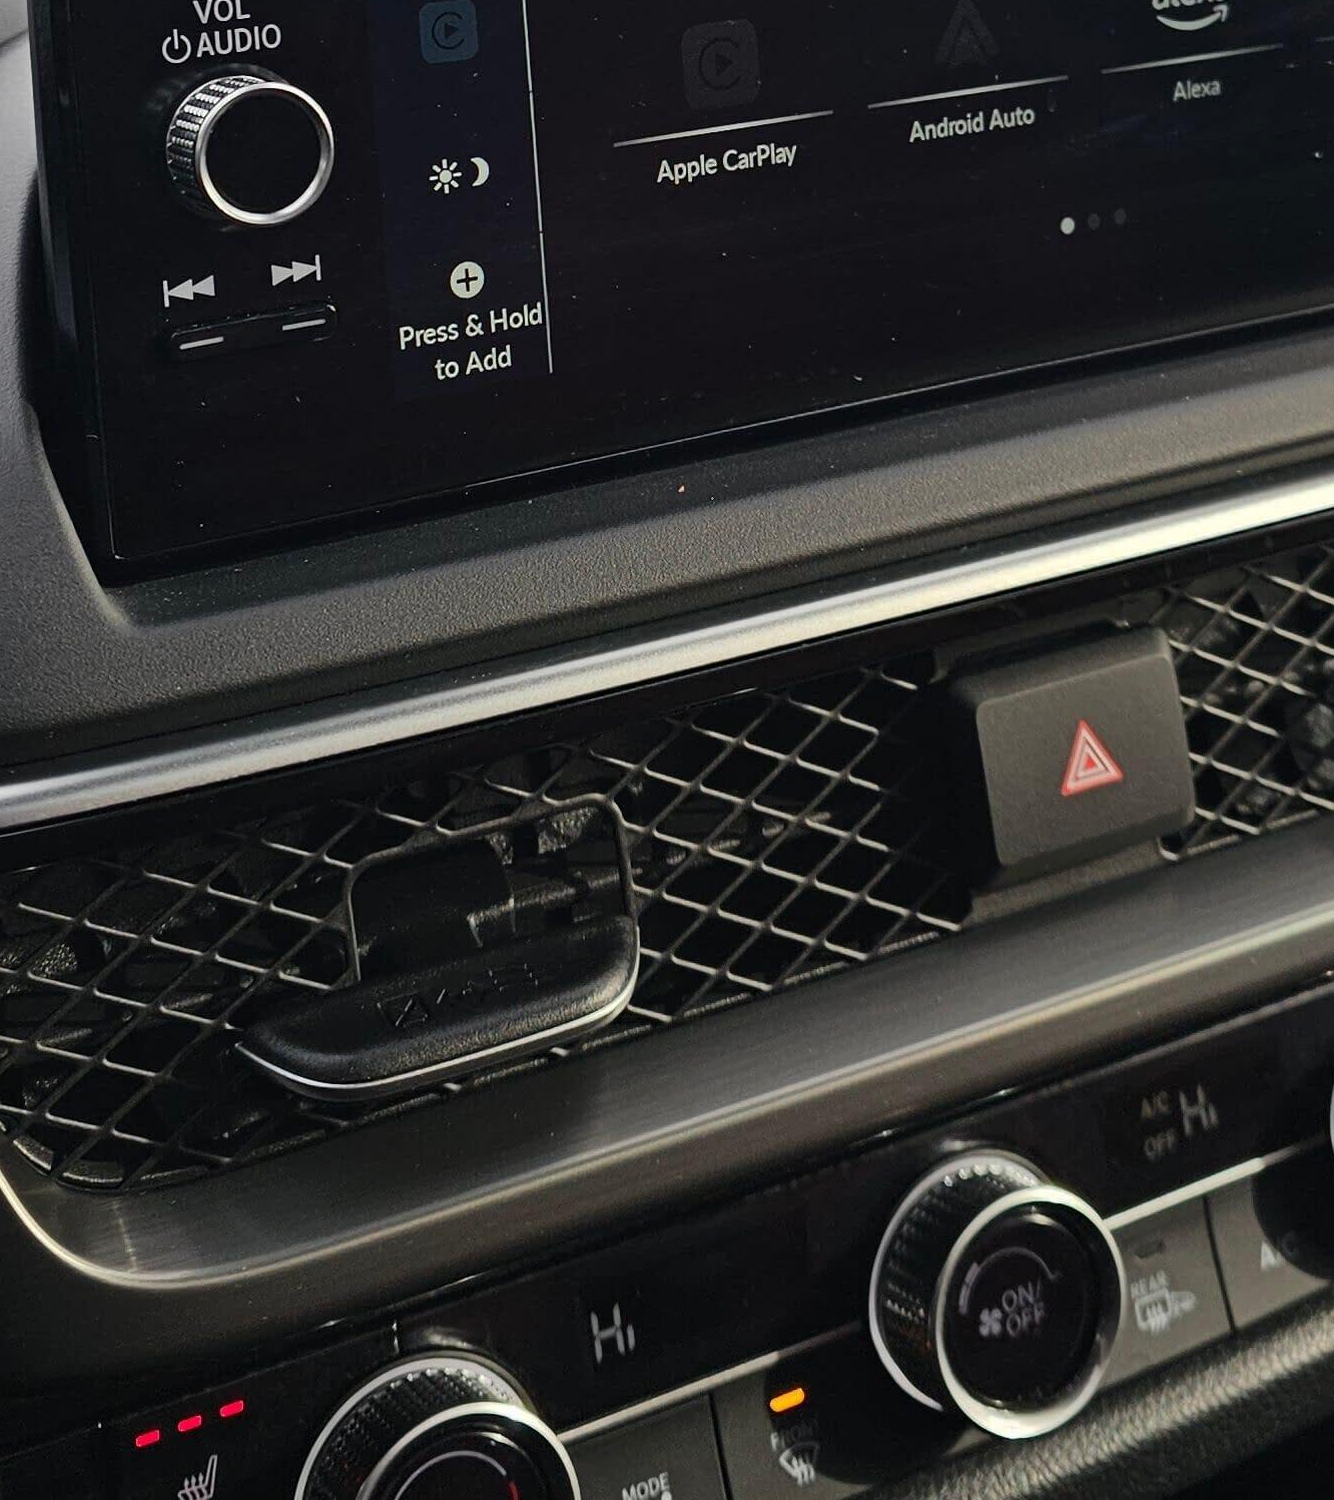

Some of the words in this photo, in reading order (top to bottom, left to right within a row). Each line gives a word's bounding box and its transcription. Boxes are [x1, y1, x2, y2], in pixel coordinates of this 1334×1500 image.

[196, 22, 282, 58] AUDIO
[1172, 79, 1221, 102] Alexa
[909, 110, 985, 143] Android
[988, 106, 1036, 131] Auto
[656, 153, 718, 185] Apple
[722, 142, 797, 172] CarPlay
[399, 323, 460, 351] Press
[465, 313, 485, 337] &
[489, 301, 543, 333] Hold
[434, 359, 460, 381] to
[465, 344, 512, 375] Add
[1006, 1301, 1045, 1337] OFF
[622, 1471, 670, 1500] MODE
